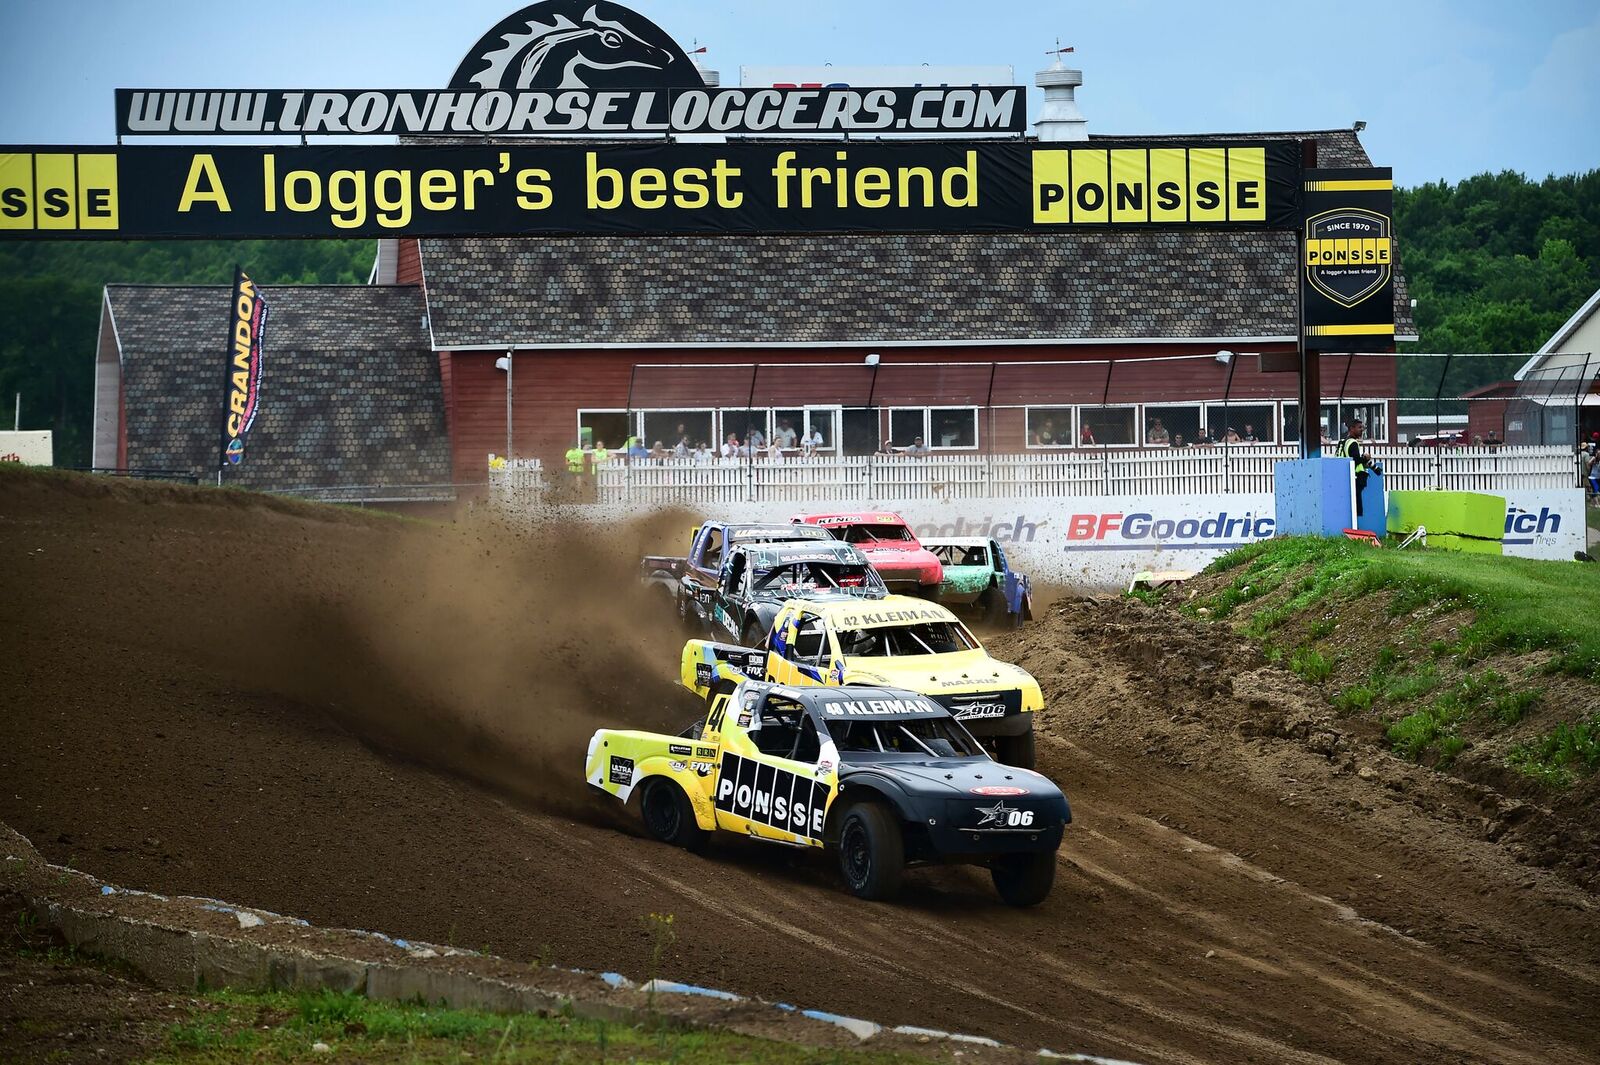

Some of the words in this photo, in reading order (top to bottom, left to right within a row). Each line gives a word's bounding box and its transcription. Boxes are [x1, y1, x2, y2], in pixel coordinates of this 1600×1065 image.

[1, 188, 111, 217] SSE
[177, 154, 232, 212] A
[263, 152, 553, 228] logger's
[586, 152, 744, 209] best
[772, 150, 978, 208] friend
[1039, 181, 1260, 212] PONSSE
[1326, 222, 1351, 232] SINCE
[1352, 223, 1371, 231] 1970
[1309, 250, 1388, 261] PONSSE
[227, 272, 255, 438] CRANDON
[844, 615, 859, 627] 42
[862, 609, 945, 625] KLEIMAN
[708, 697, 733, 733] 4
[843, 700, 934, 715] KLEIMAN
[612, 763, 633, 774] ULTRA
[719, 778, 824, 832] PONSSE
